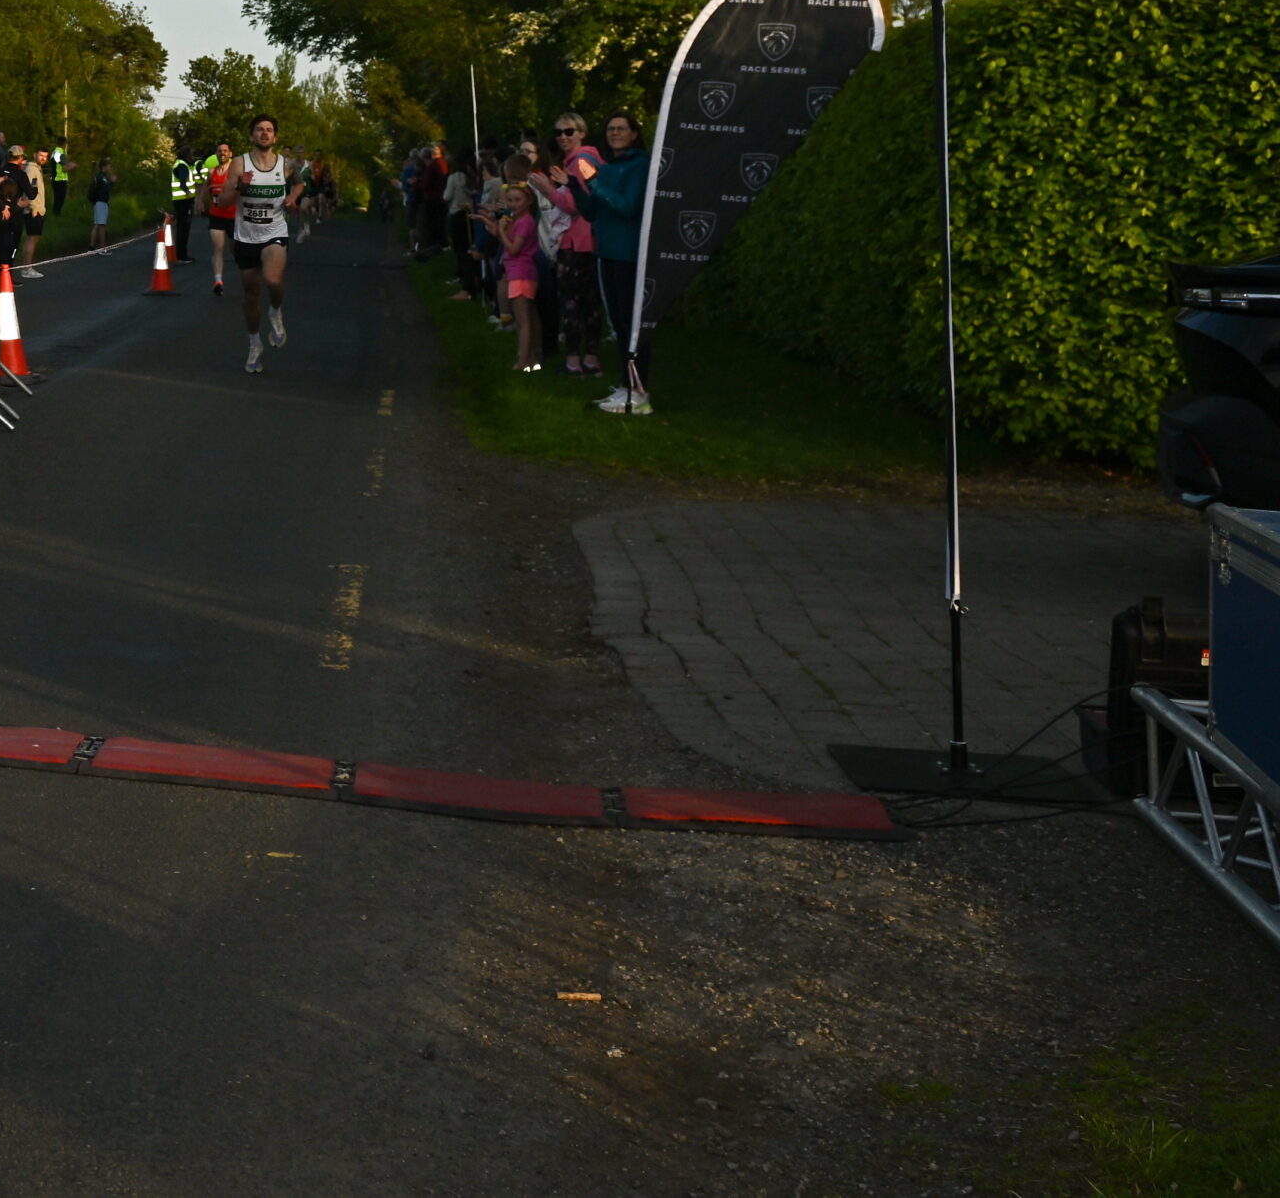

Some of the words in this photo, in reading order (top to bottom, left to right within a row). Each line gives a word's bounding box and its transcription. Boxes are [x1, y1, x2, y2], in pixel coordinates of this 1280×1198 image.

[838, 0, 871, 8] SERIE
[740, 64, 768, 73] RACE
[770, 66, 807, 75] SERIES
[679, 121, 706, 131] RACE
[709, 124, 745, 134] SERIES
[721, 194, 748, 202] RACE
[660, 252, 687, 261] RACE
